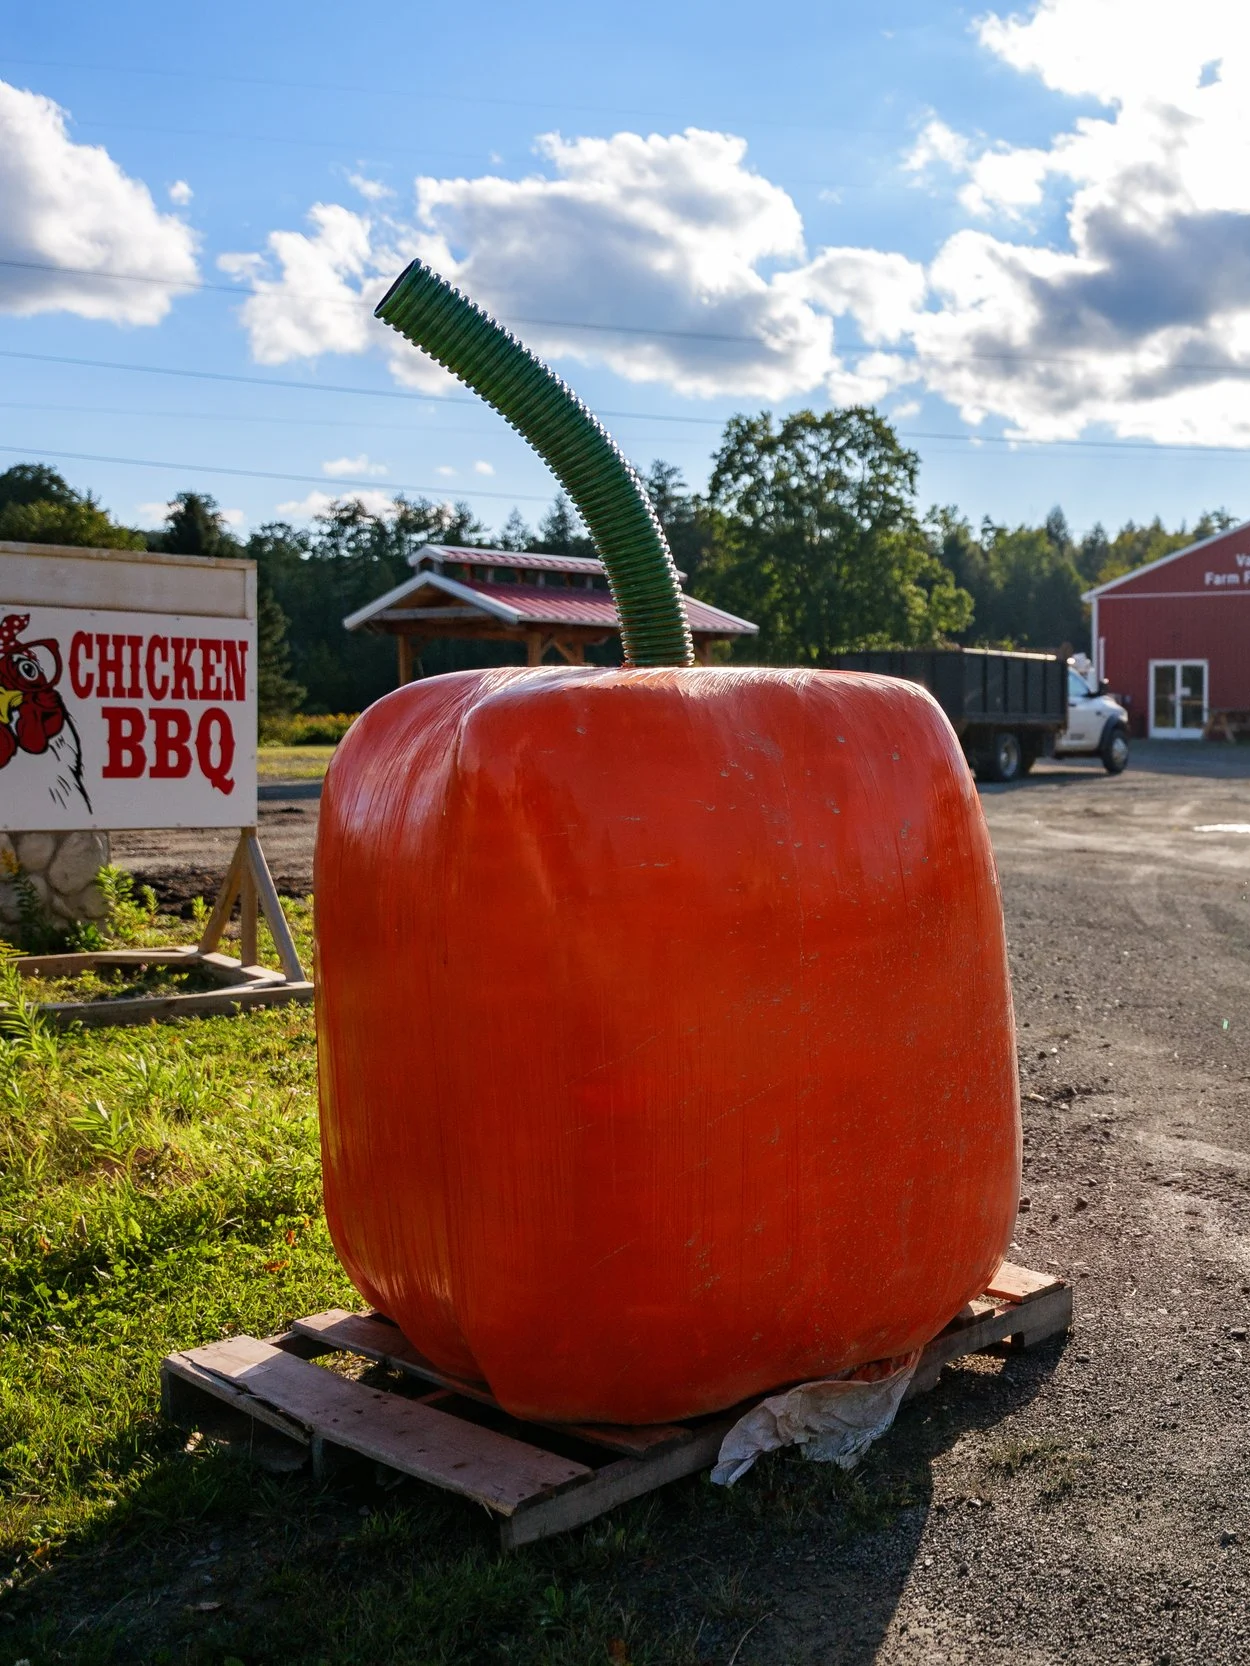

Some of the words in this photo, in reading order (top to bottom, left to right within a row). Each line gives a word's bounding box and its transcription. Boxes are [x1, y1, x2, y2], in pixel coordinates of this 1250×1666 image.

[1204, 572, 1240, 585] Farm
[69, 630, 249, 701] CHICKEN
[101, 706, 236, 796] BBQ
